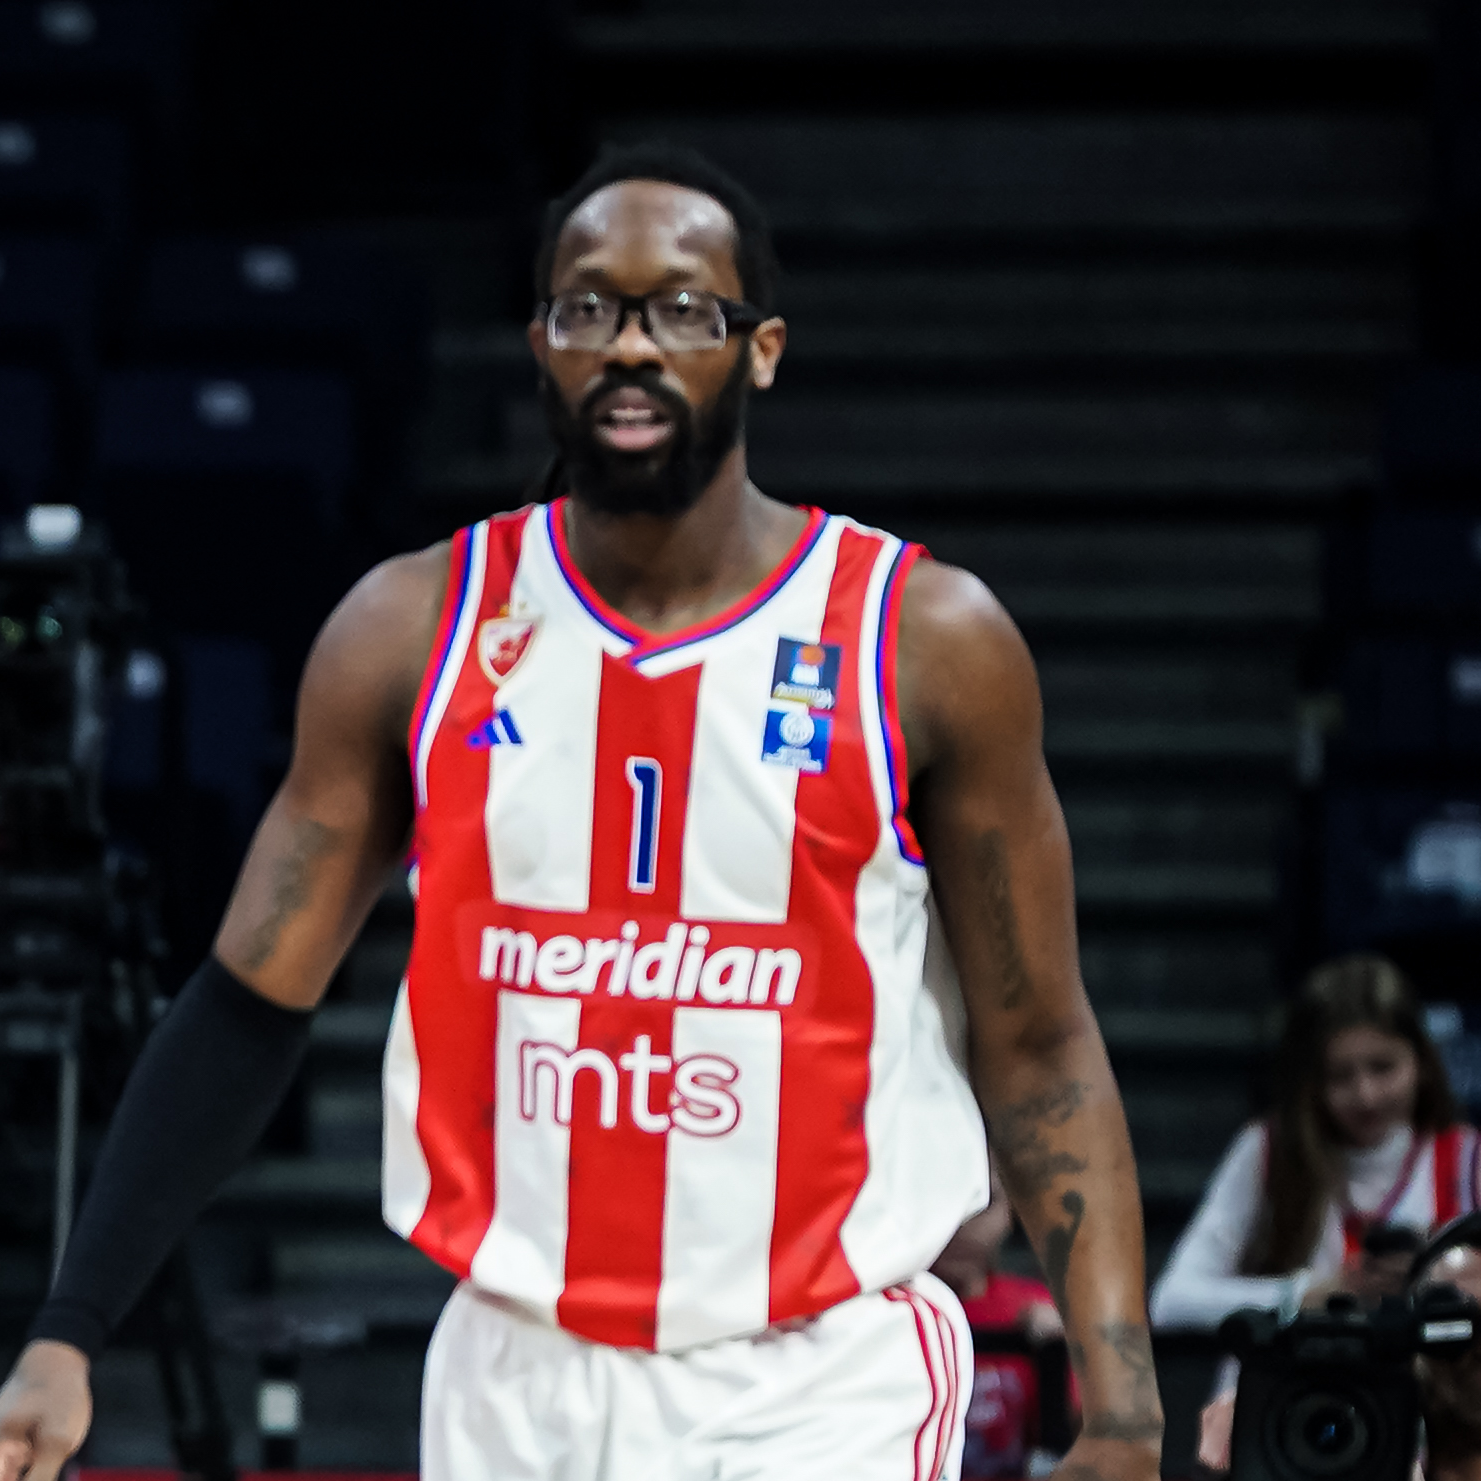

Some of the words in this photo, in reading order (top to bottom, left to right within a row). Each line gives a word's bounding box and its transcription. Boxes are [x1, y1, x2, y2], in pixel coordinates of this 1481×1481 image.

[627, 757, 662, 892] 1
[478, 920, 802, 1007] meridian
[519, 1033, 741, 1137] mts
